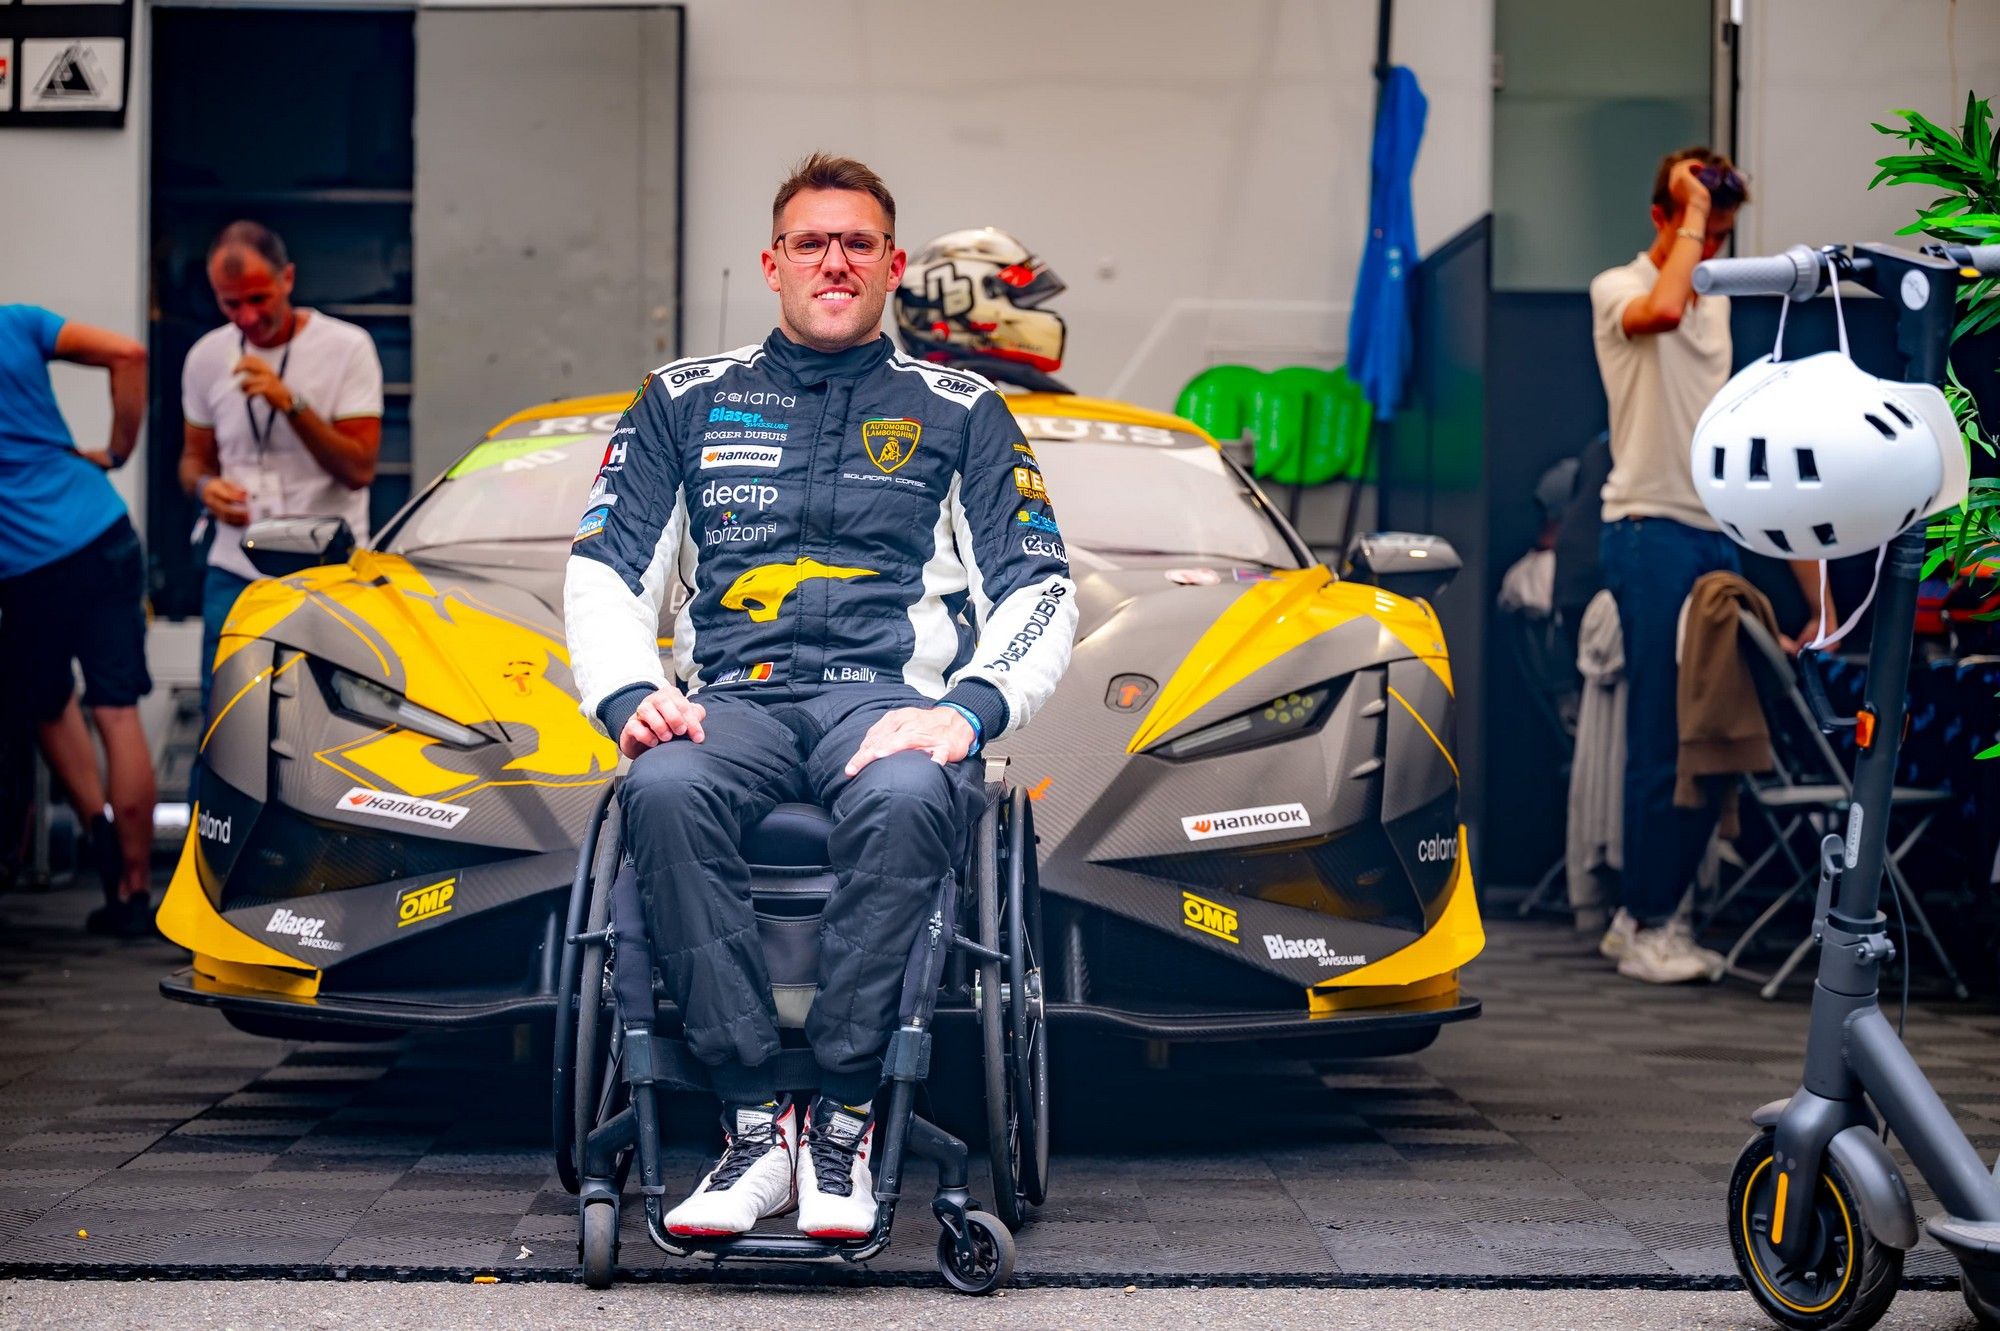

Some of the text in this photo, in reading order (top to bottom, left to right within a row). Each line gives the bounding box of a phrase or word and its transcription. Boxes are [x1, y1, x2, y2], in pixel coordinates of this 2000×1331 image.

[671, 368, 711, 384] OMP
[936, 378, 977, 394] OMP
[714, 390, 797, 408] caland
[866, 430, 916, 440] LAMBORGHINI
[869, 423, 914, 432] AUTOMOBILI
[704, 430, 788, 442] ROGER DUBUIS
[843, 473, 893, 483] SQUADRA
[703, 477, 779, 511] decip
[823, 667, 877, 683] N. Bailly
[400, 884, 454, 920] OMP
[1184, 899, 1239, 935] OMP
